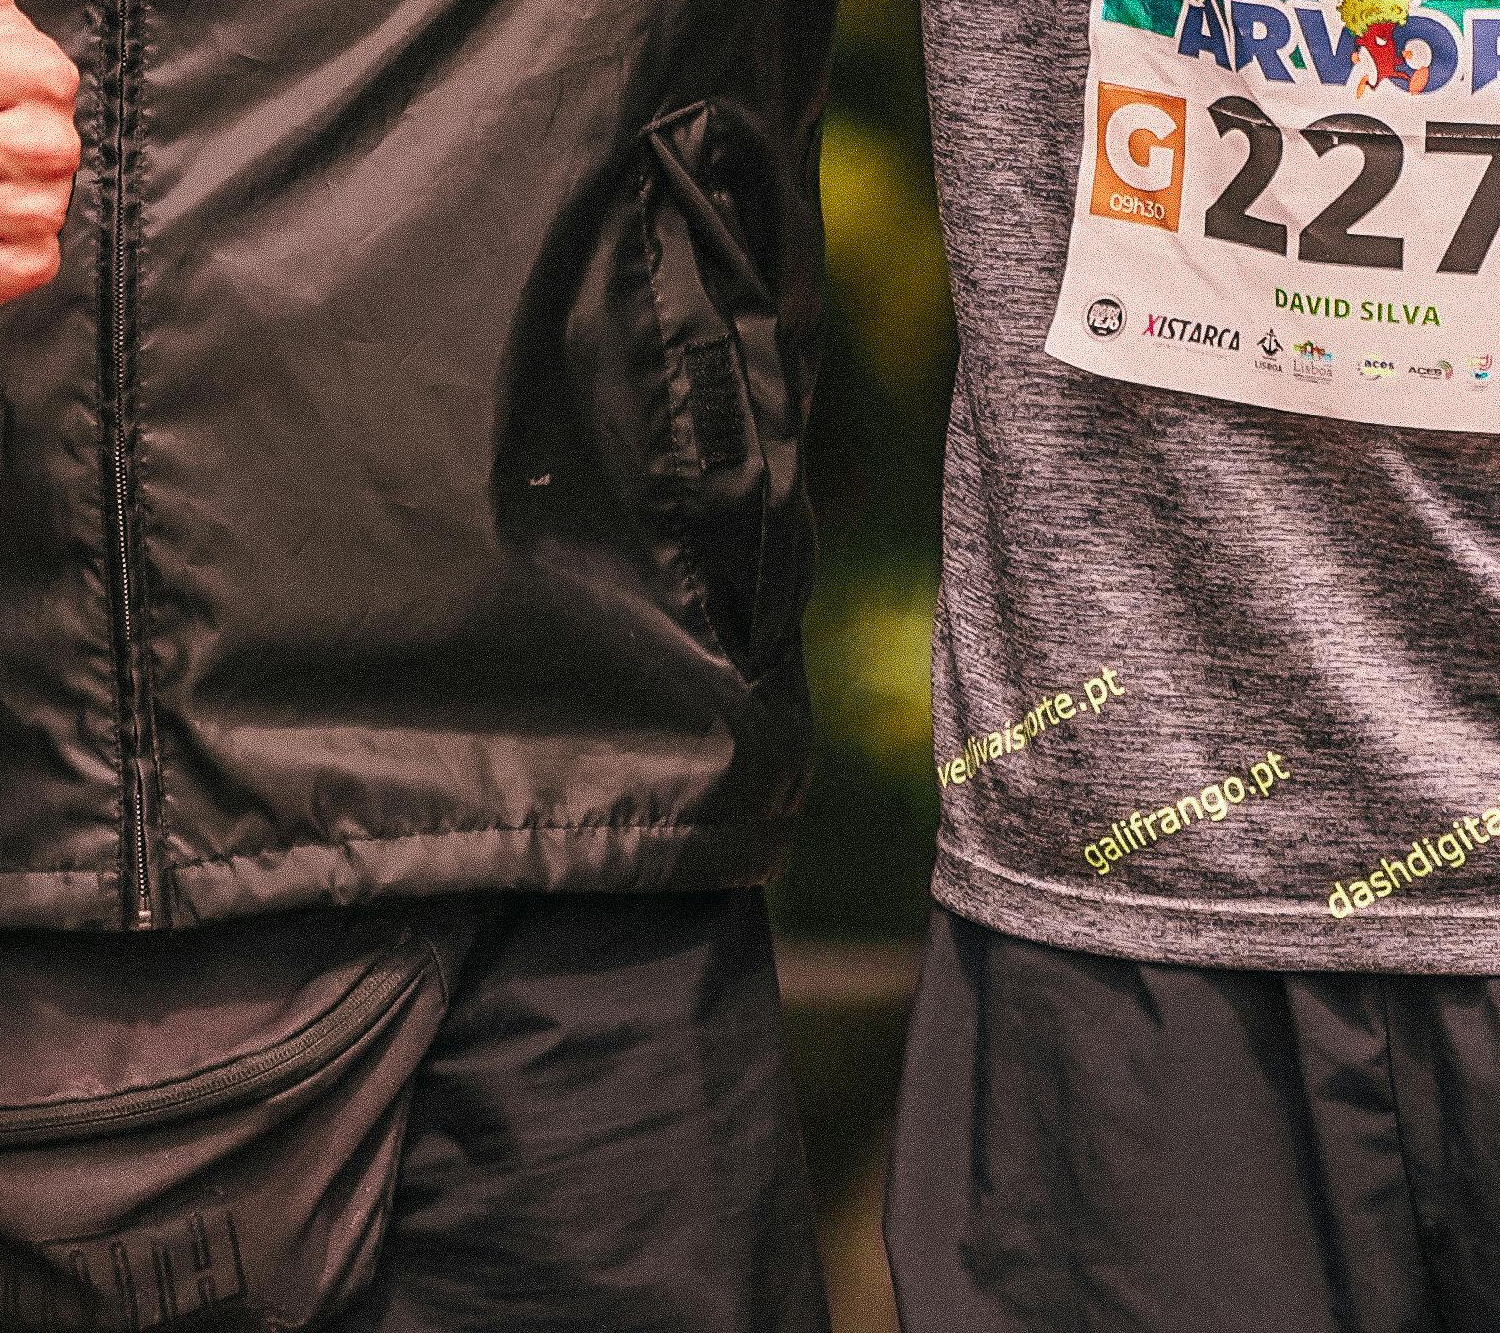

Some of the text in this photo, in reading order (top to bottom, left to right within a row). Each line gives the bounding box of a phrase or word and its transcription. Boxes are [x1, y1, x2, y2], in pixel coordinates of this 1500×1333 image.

[1106, 103, 1176, 191] G
[1109, 193, 1165, 221] 09h30
[1275, 288, 1440, 328] DAVID SILVA
[1144, 314, 1240, 351] XISTARCA
[1084, 750, 1292, 875] galifrango.pt
